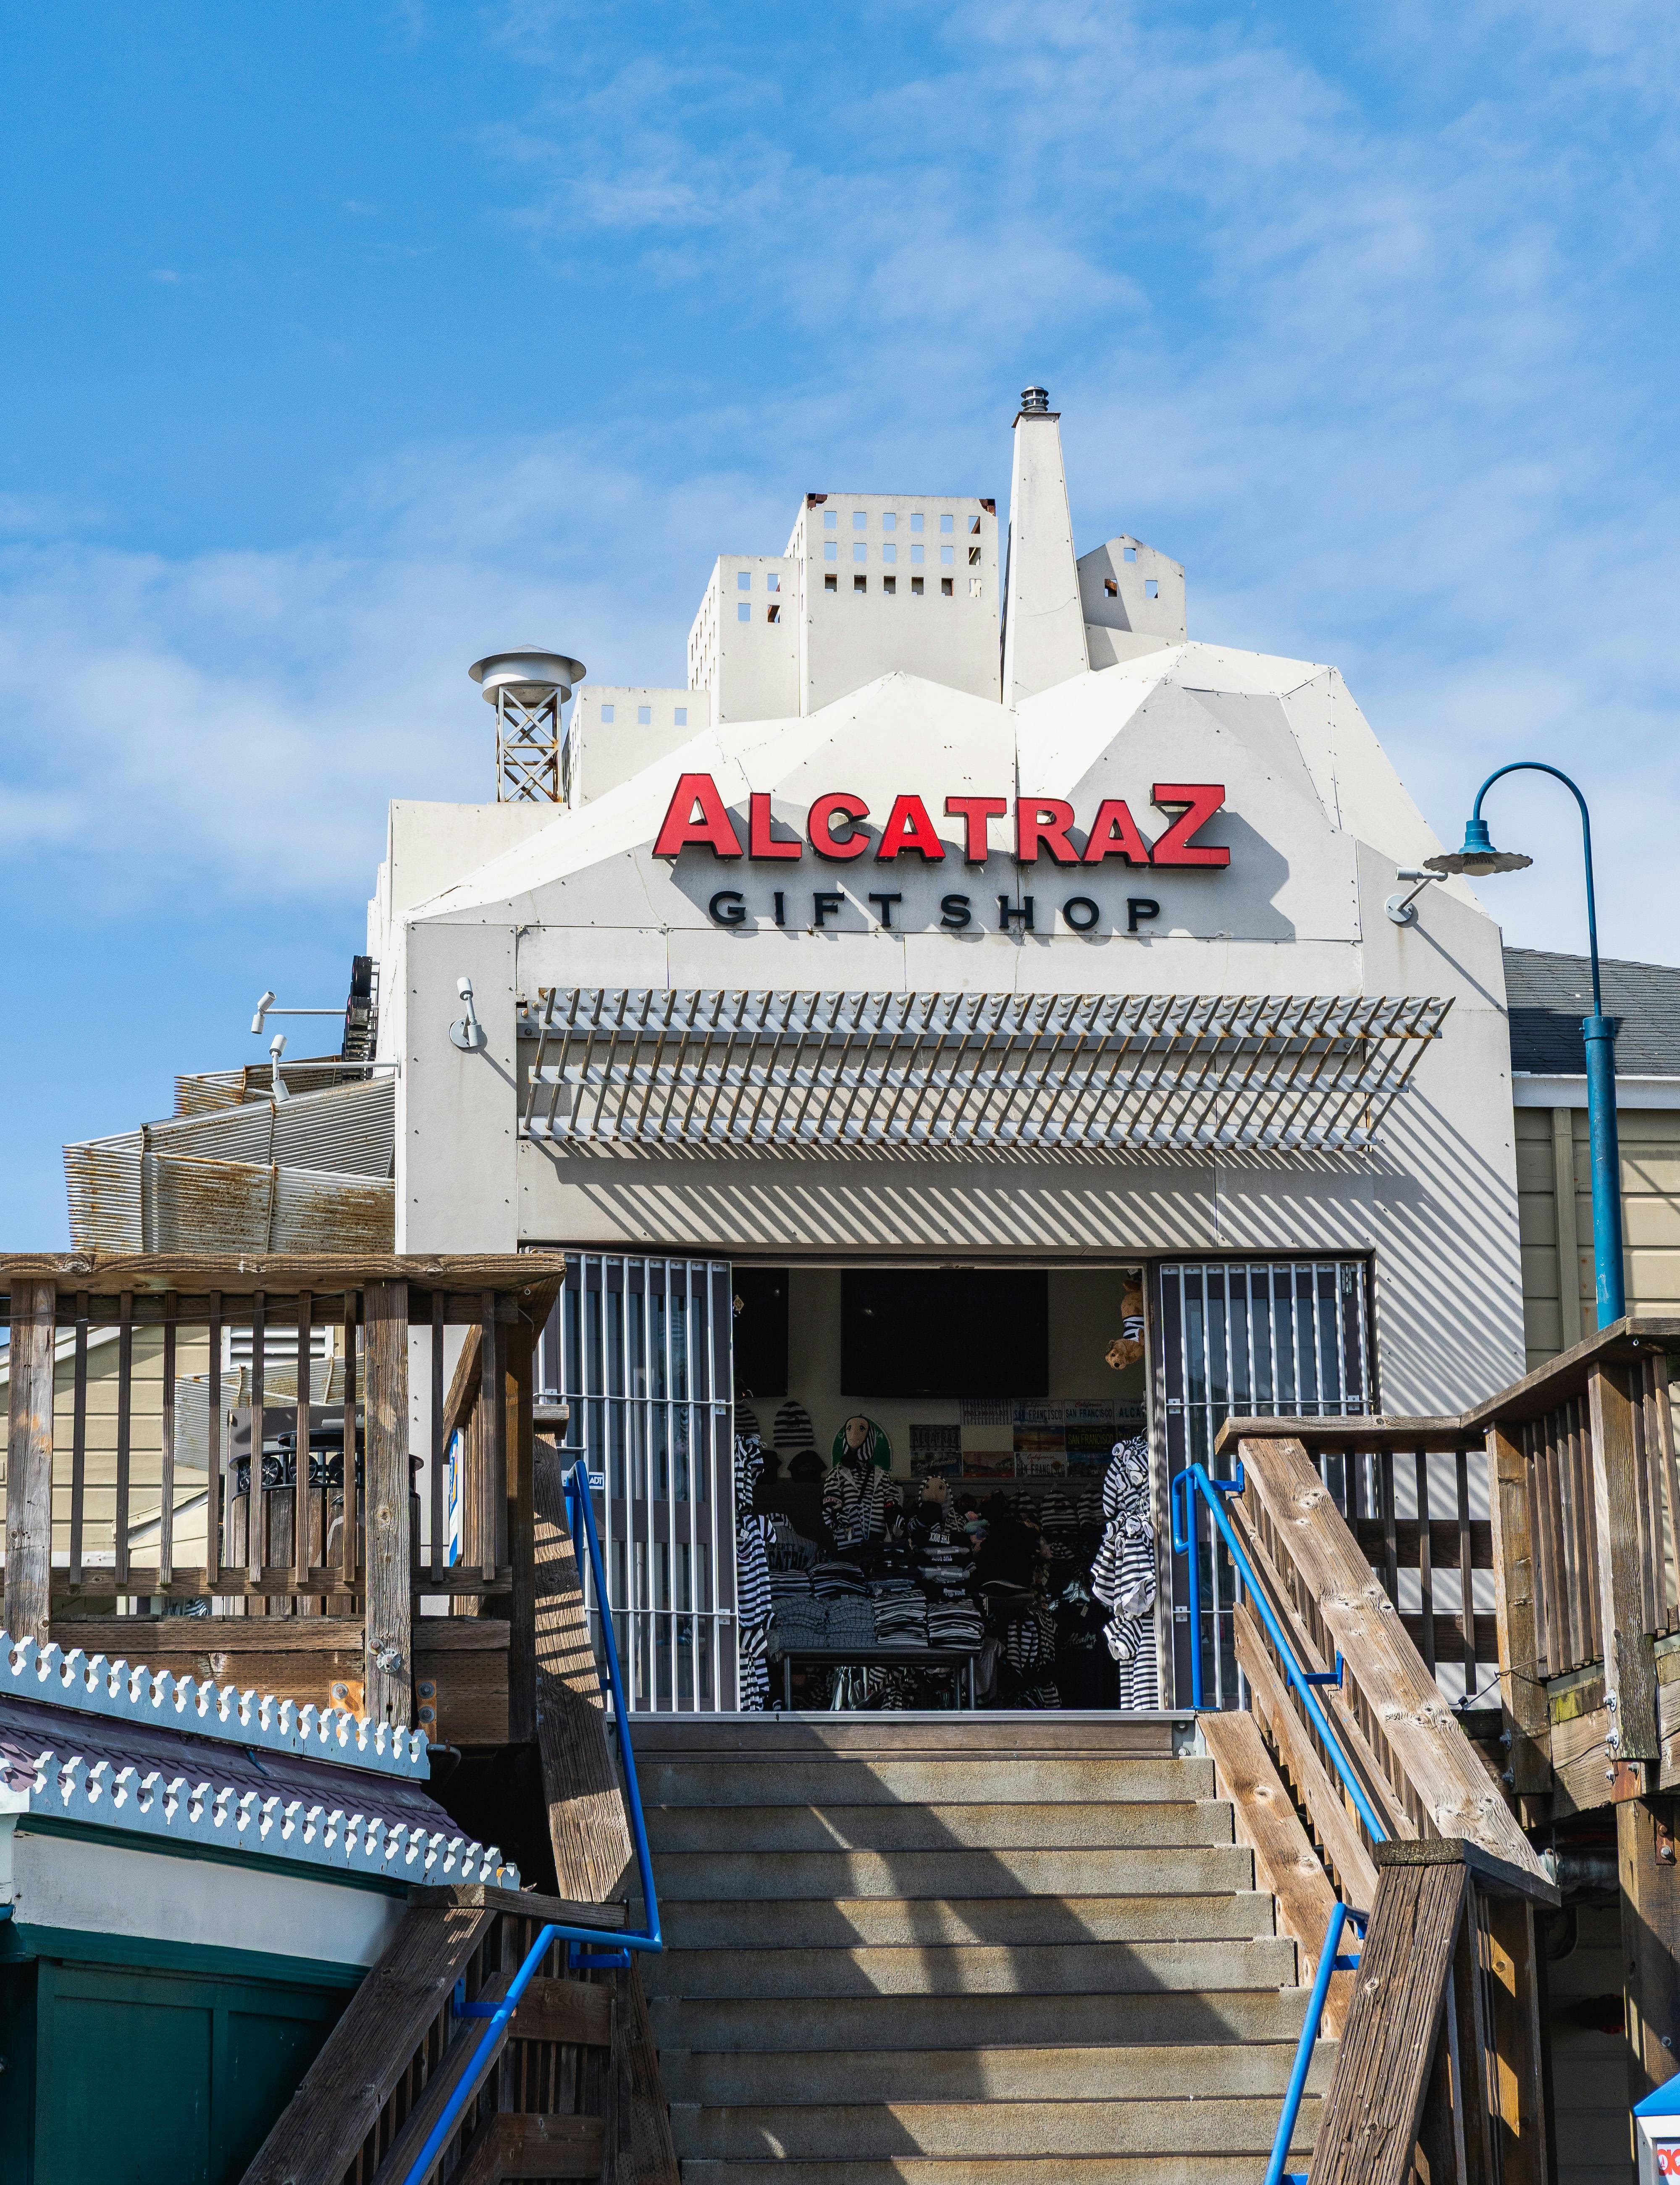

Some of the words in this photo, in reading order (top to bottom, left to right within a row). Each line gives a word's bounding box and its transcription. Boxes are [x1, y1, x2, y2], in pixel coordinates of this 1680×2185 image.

[651, 773, 1231, 869] ALCATRAZ
[709, 891, 902, 927] GIFT
[940, 894, 1160, 931] SHOP
[1014, 1409, 1025, 1420] SAN
[1029, 1409, 1062, 1420] FRANCISCO
[1066, 1409, 1076, 1418] SAN
[1080, 1409, 1112, 1418] FRANCISCO
[914, 1432, 958, 1444] ALCATRAZ
[1068, 1434, 1080, 1445] SAN
[1081, 1434, 1114, 1445] FRANCISCO
[589, 1476, 603, 1485] ADT
[929, 1532, 940, 1543] ROCK
[940, 1534, 950, 1544] THE
[1061, 1632, 1097, 1649] Alcatraz
